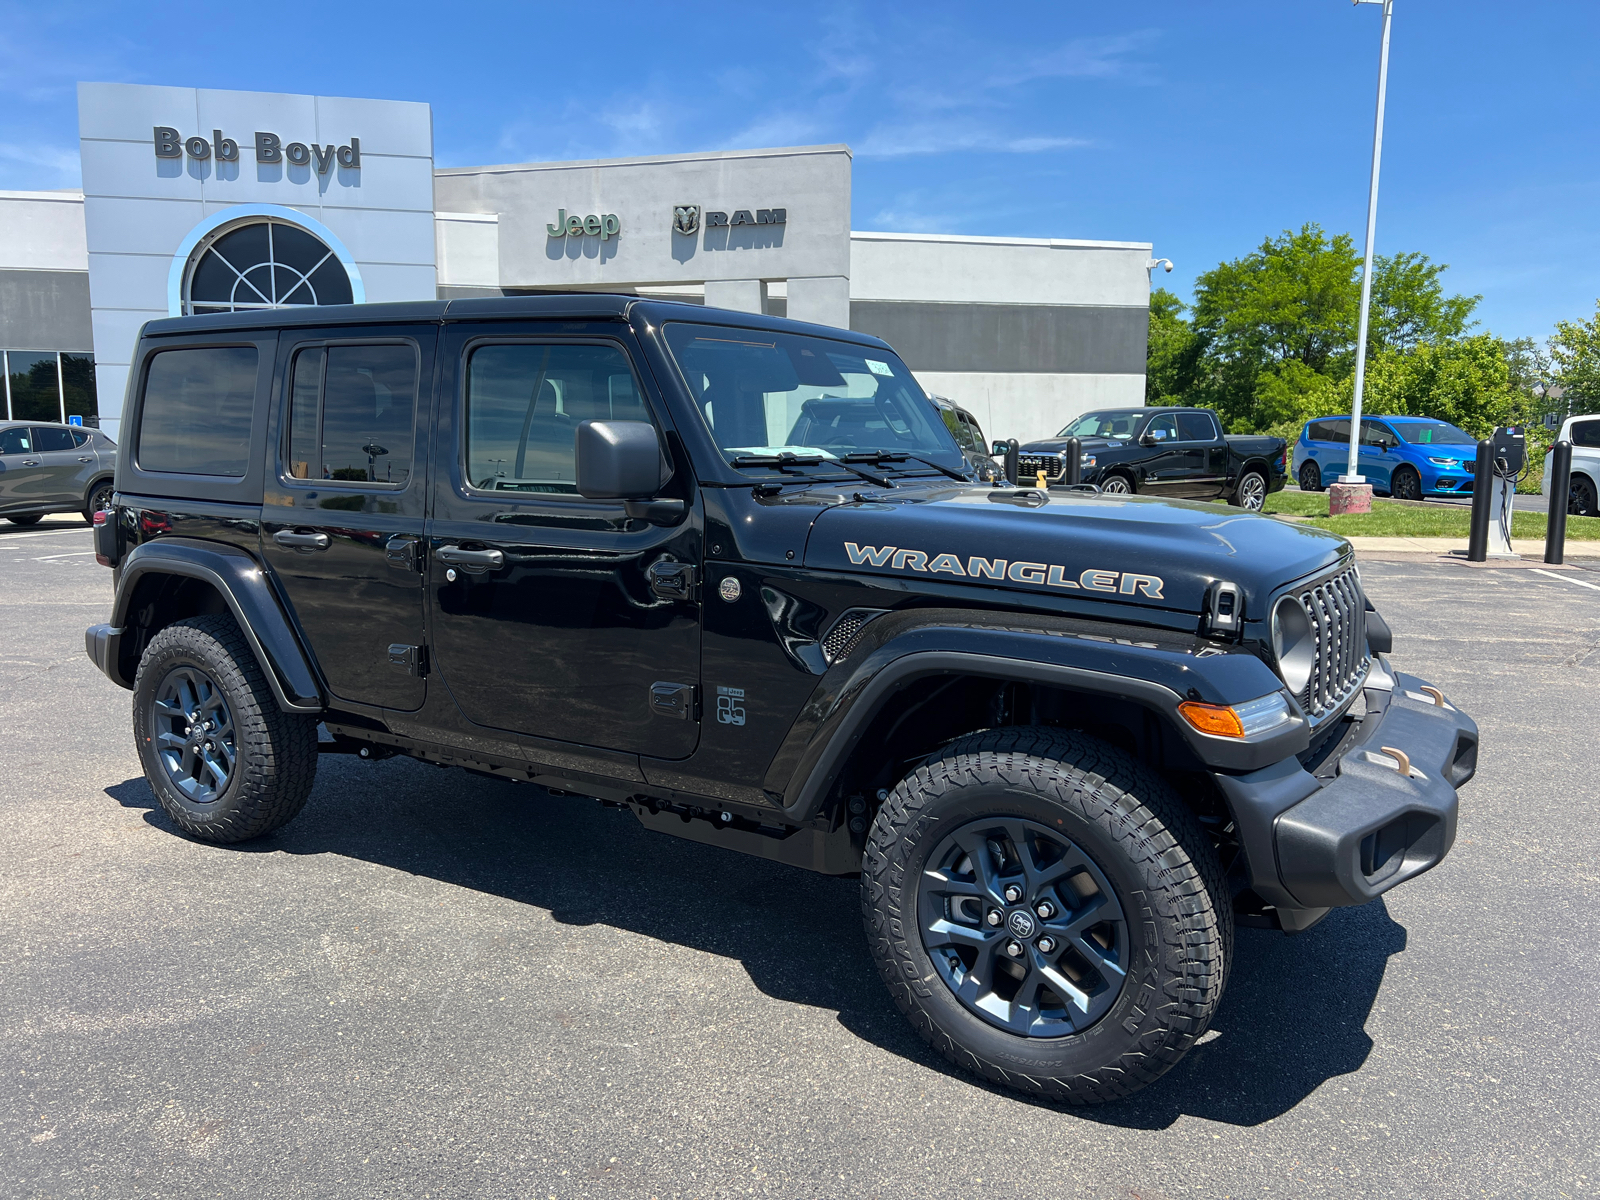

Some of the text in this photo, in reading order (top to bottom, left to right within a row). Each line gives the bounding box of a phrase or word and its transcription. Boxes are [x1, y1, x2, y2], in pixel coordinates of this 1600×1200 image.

[153, 126, 361, 173] Bob Boyd
[546, 208, 620, 241] Jeep
[705, 208, 787, 228] RAM
[844, 541, 1165, 600] WRANGLER
[717, 696, 745, 726] 85
[729, 688, 744, 697] Jeep
[887, 807, 940, 998] ROADIAN ATX
[1121, 889, 1160, 1037] NEXEN
